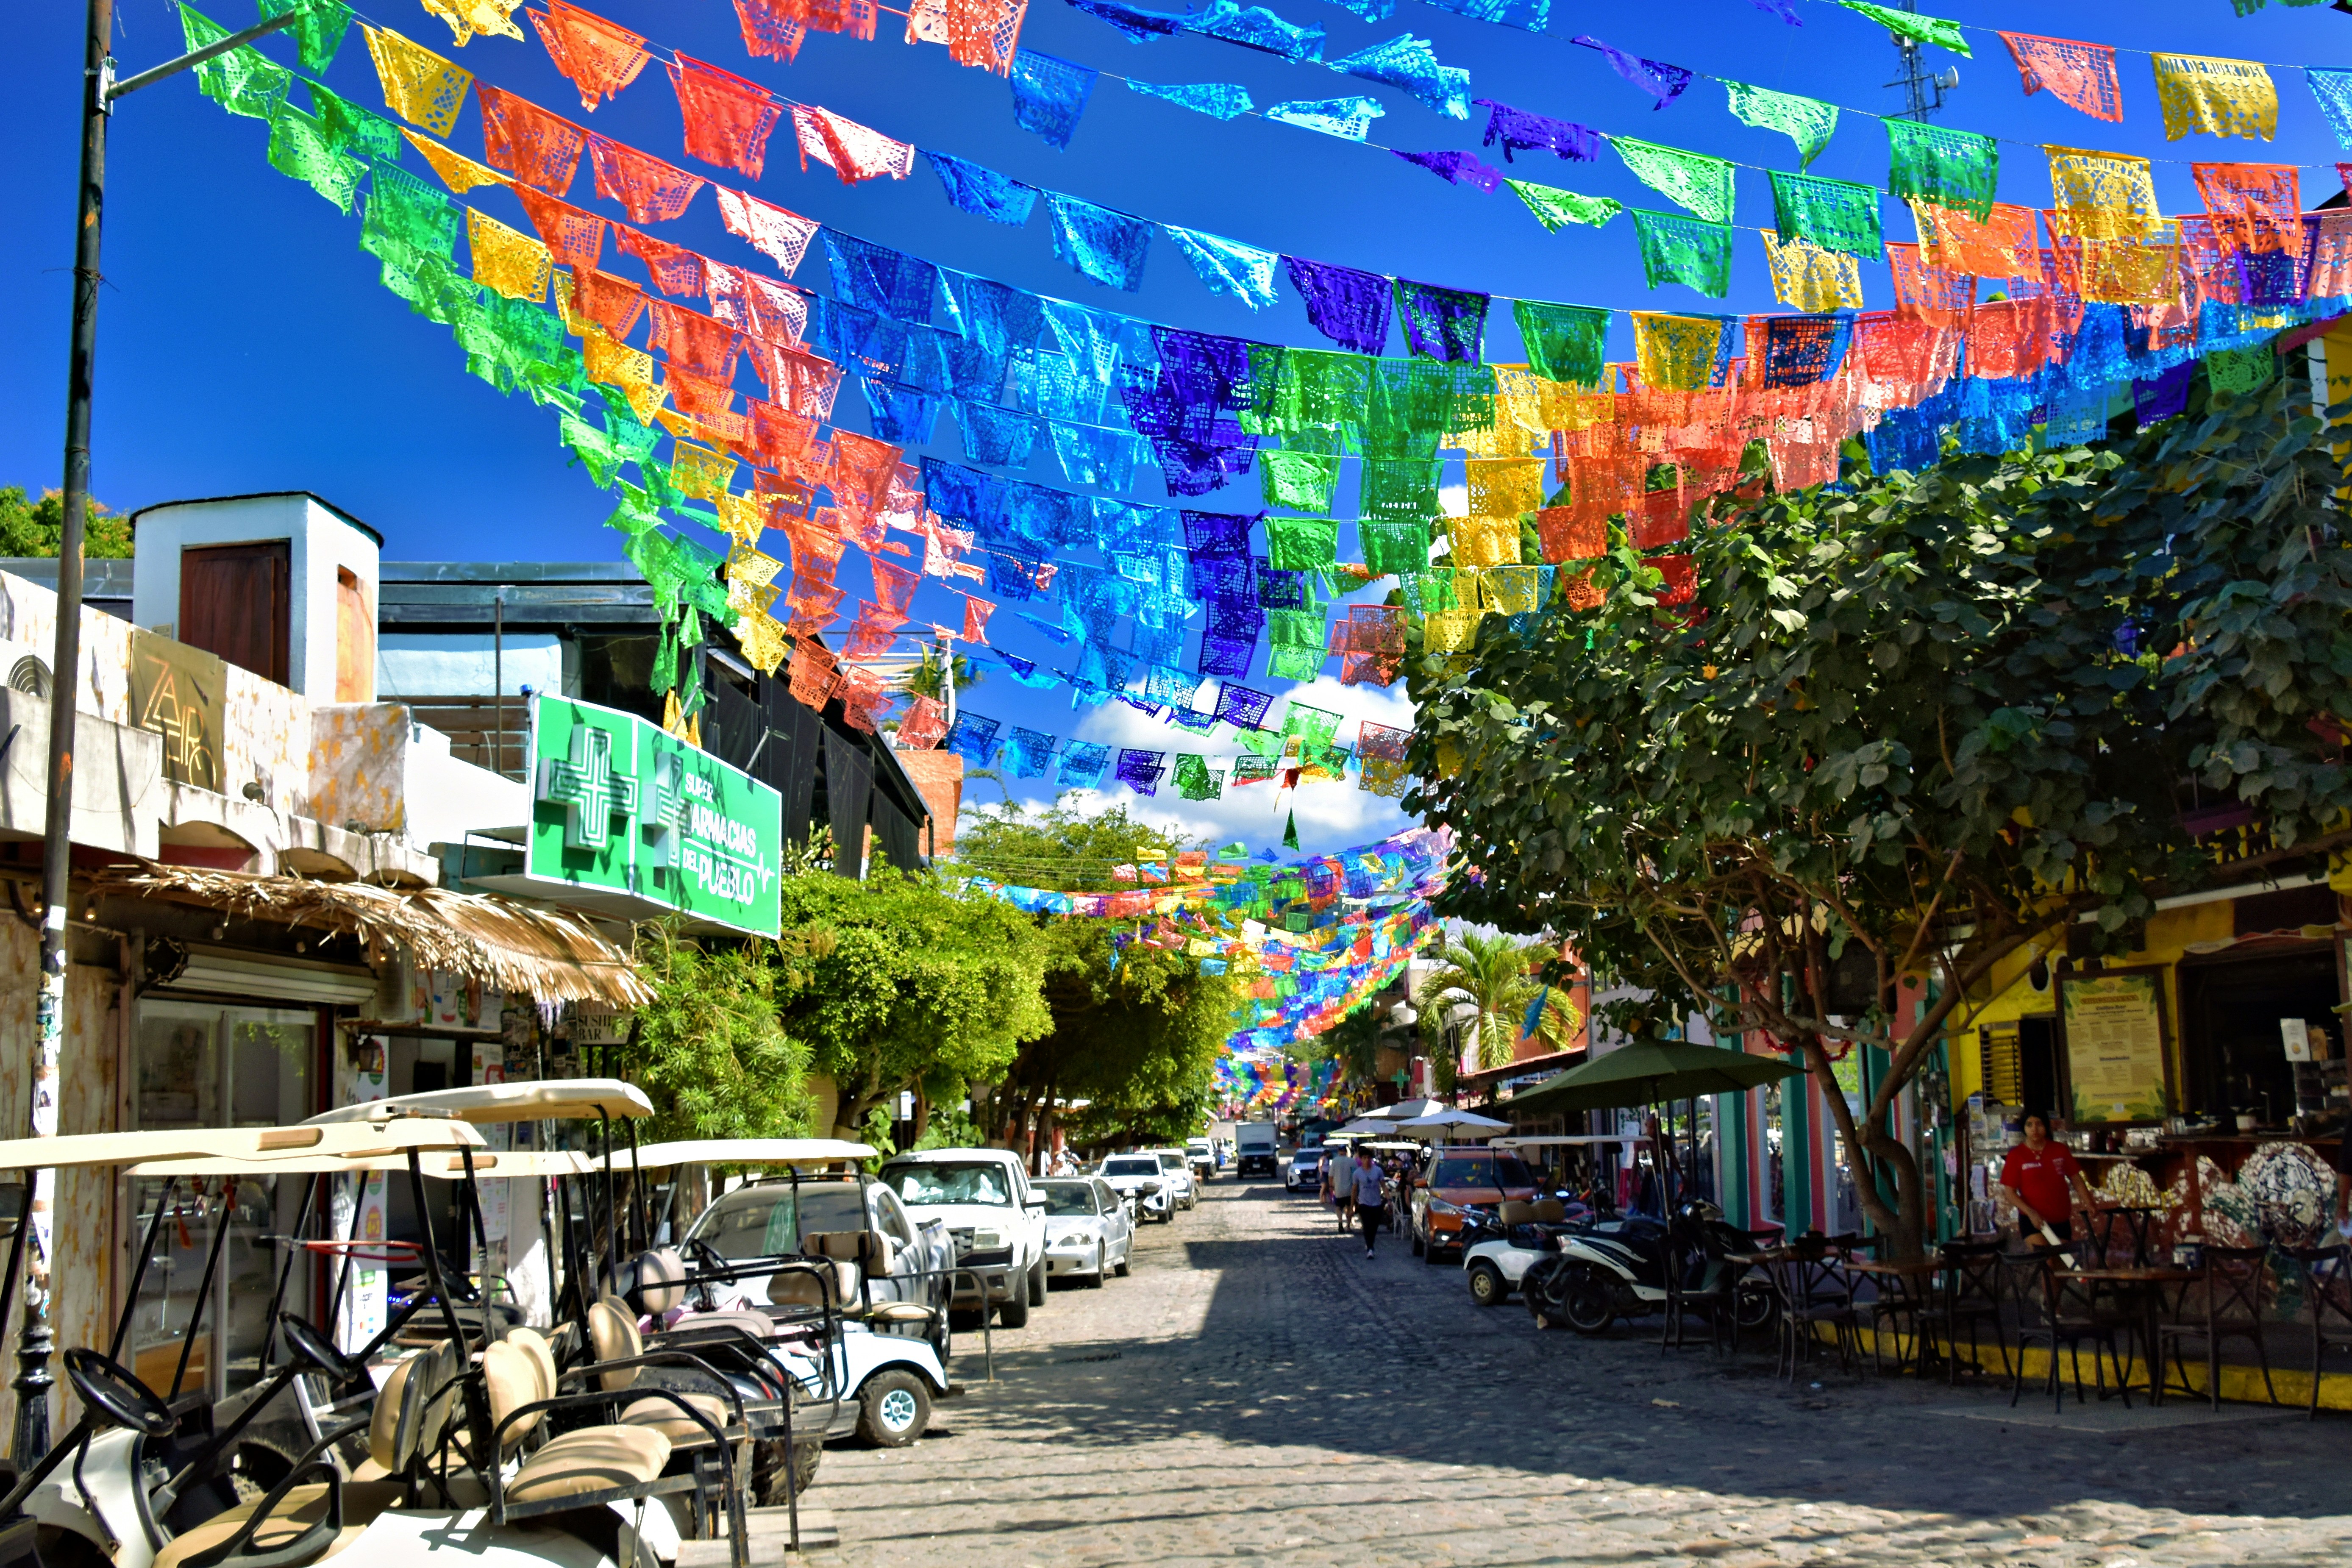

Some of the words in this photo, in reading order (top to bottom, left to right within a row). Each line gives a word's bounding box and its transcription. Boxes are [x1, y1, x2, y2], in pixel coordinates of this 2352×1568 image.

[685, 772, 713, 803] SUPER
[690, 803, 756, 858] ARMACIAS
[683, 848, 698, 873] DEL
[698, 854, 754, 905] PUEBLO
[578, 1015, 611, 1026] SUSHI
[579, 1029, 601, 1040] BAR
